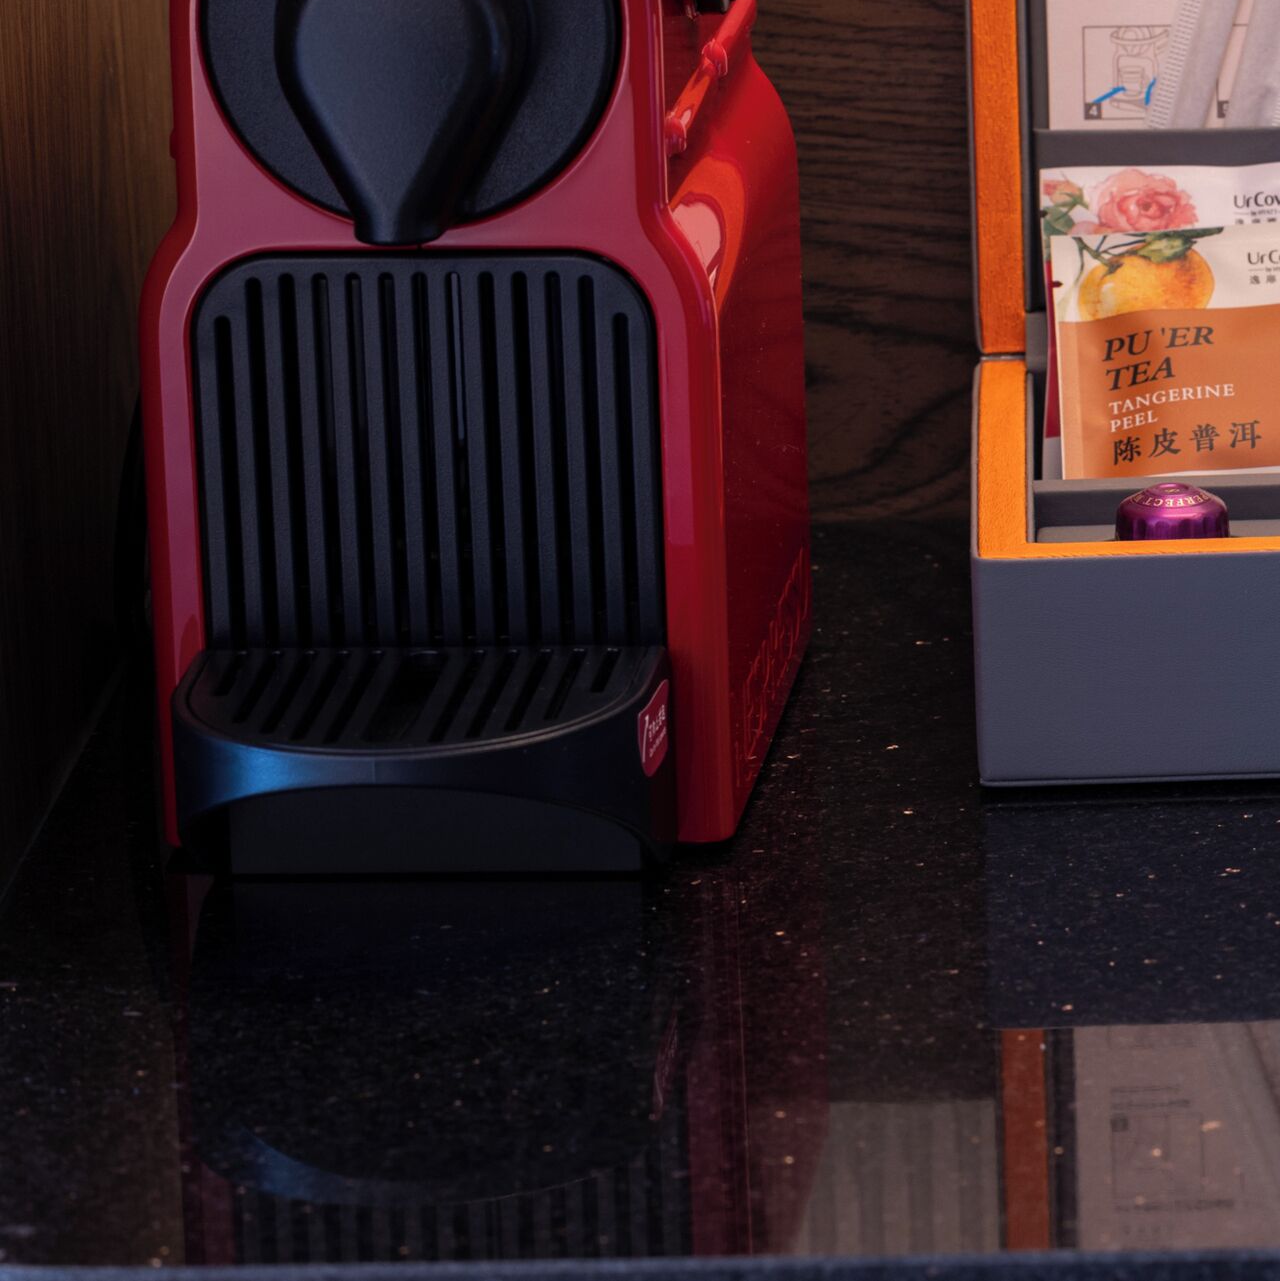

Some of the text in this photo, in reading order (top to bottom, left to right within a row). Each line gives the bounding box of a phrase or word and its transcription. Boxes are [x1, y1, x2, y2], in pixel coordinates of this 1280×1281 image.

[1106, 356, 1176, 392] TEA
[1108, 383, 1236, 416] TANGERINE
[1110, 410, 1158, 433] PEEL
[1113, 420, 1262, 465] 陈皮普洱
